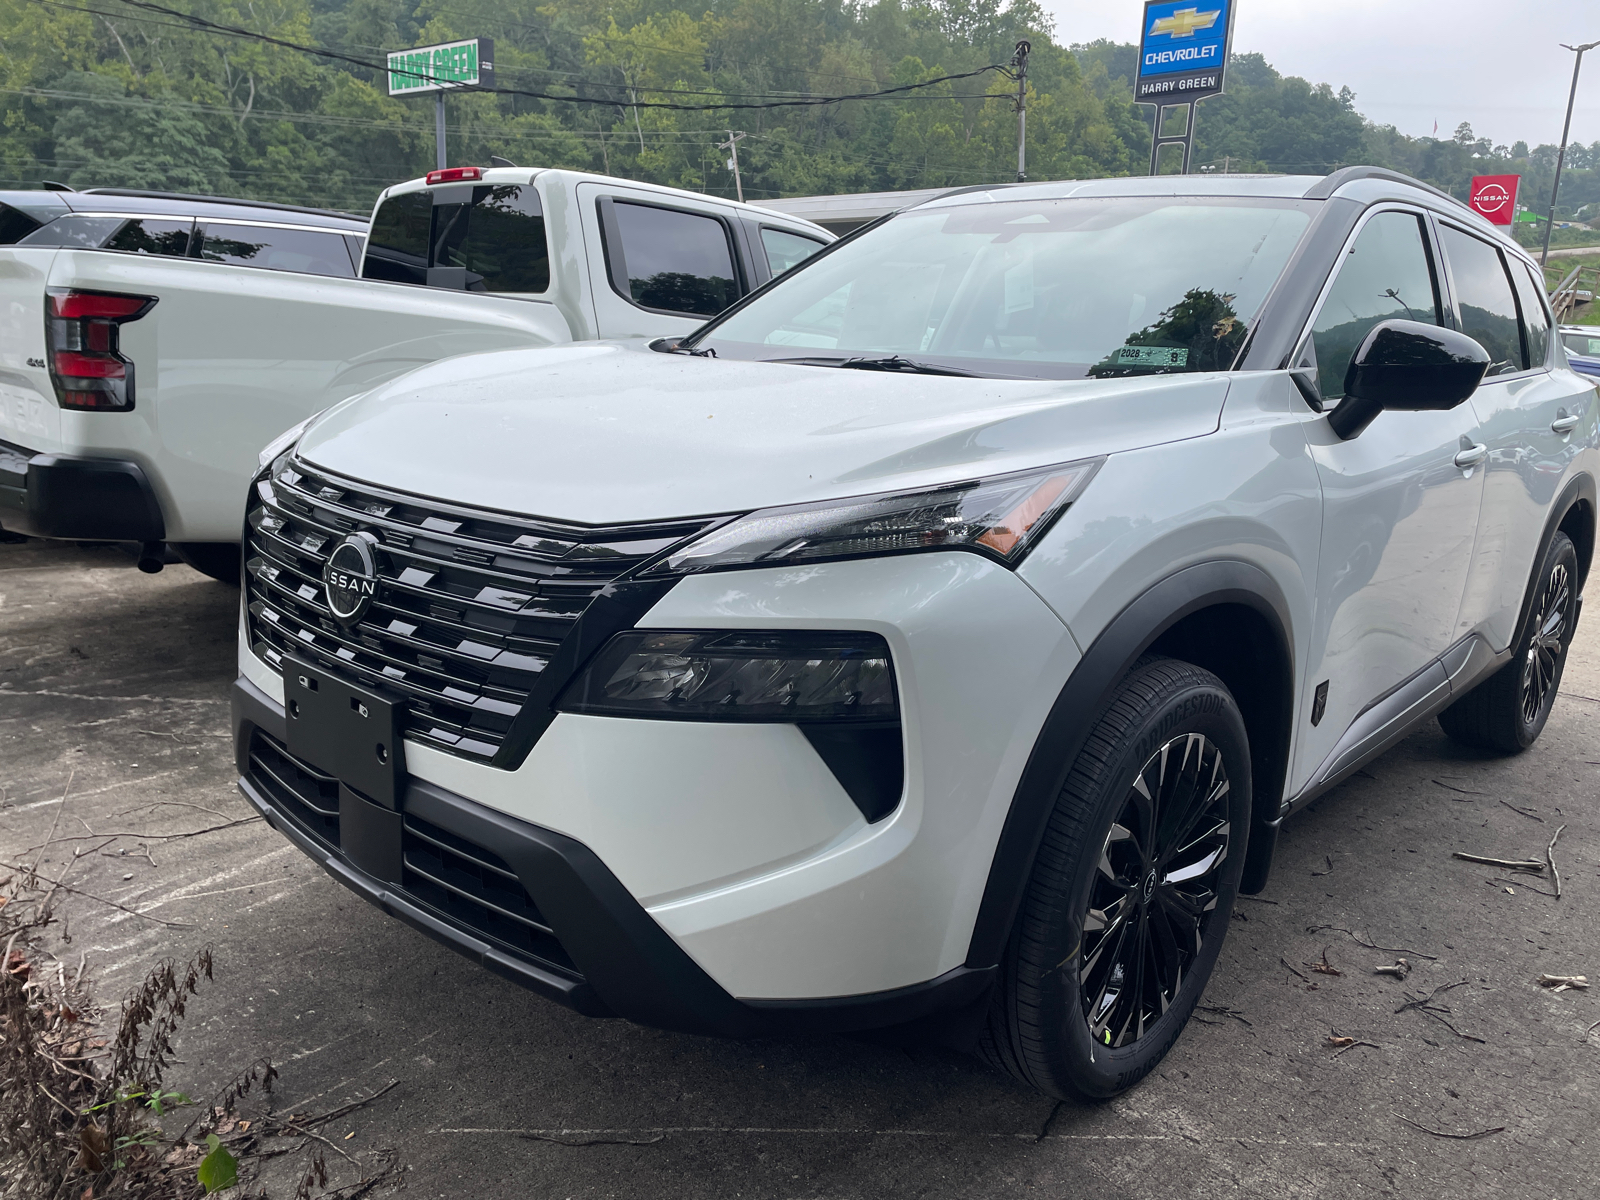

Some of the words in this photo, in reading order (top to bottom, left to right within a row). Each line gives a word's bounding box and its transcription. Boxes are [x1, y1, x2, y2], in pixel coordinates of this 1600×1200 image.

[390, 51, 431, 90] HARRY
[433, 43, 477, 84] GREEN
[1145, 45, 1218, 65] CHEVROLET
[1141, 81, 1176, 94] HARRY
[1178, 76, 1216, 90] GREEN
[1120, 348, 1141, 358] 2028
[323, 565, 375, 595] ISSAN
[1135, 694, 1226, 762] BRIDGESTONE
